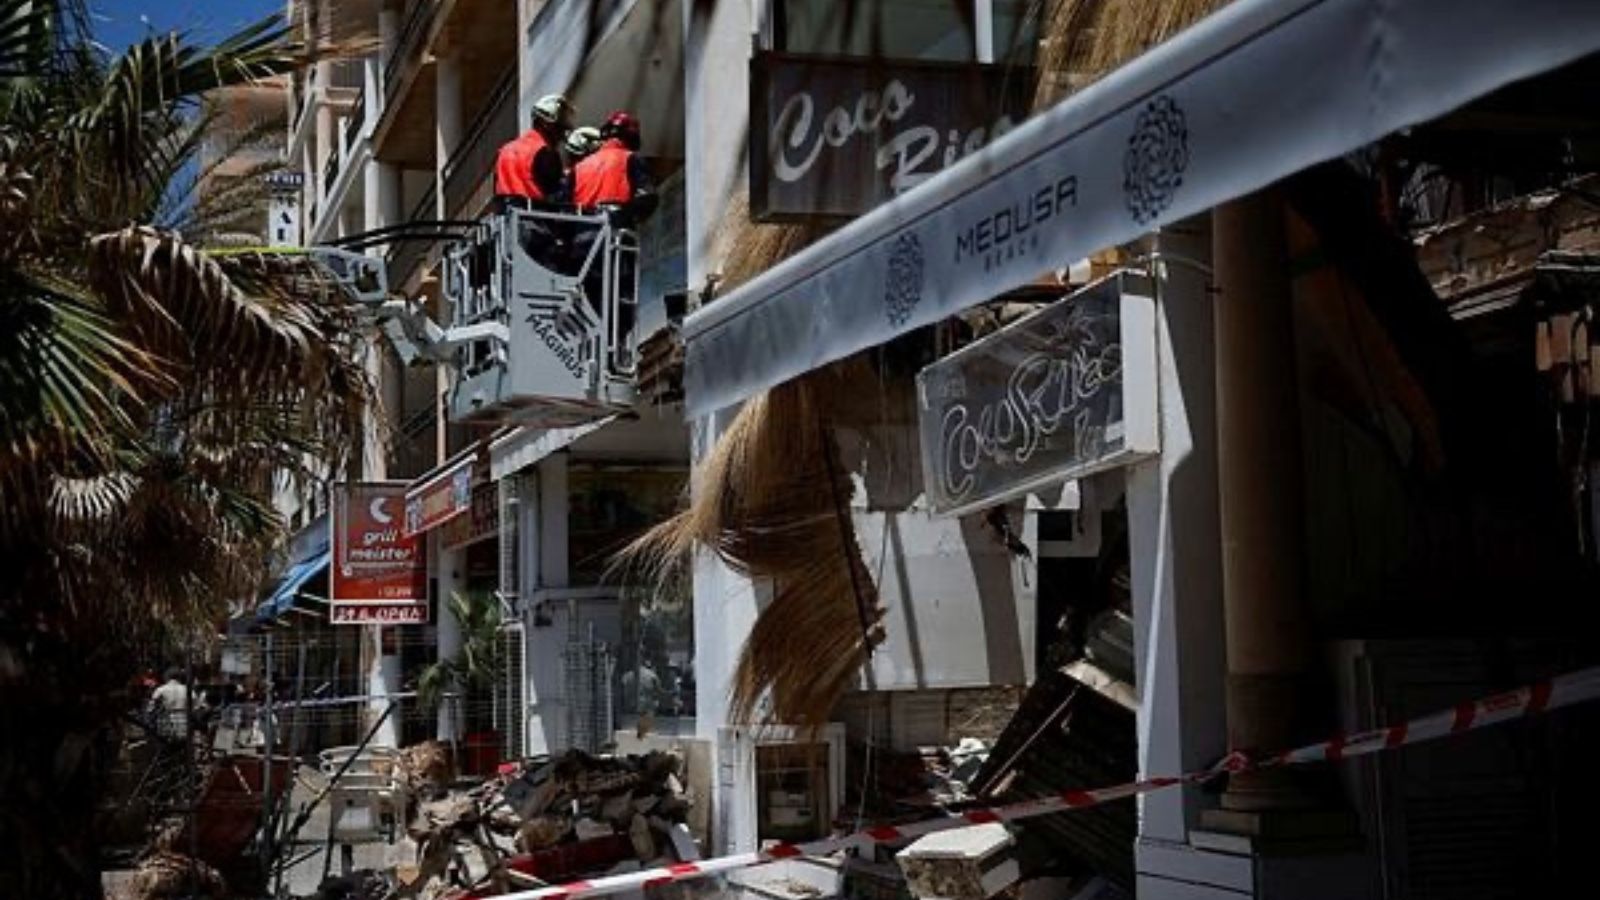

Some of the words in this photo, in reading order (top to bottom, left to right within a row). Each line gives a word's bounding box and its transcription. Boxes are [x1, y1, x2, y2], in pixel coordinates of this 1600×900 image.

[773, 80, 915, 181] Coco
[955, 174, 1078, 264] MEDUSA
[525, 313, 588, 379] MAGIRUS
[363, 530, 399, 545] grill
